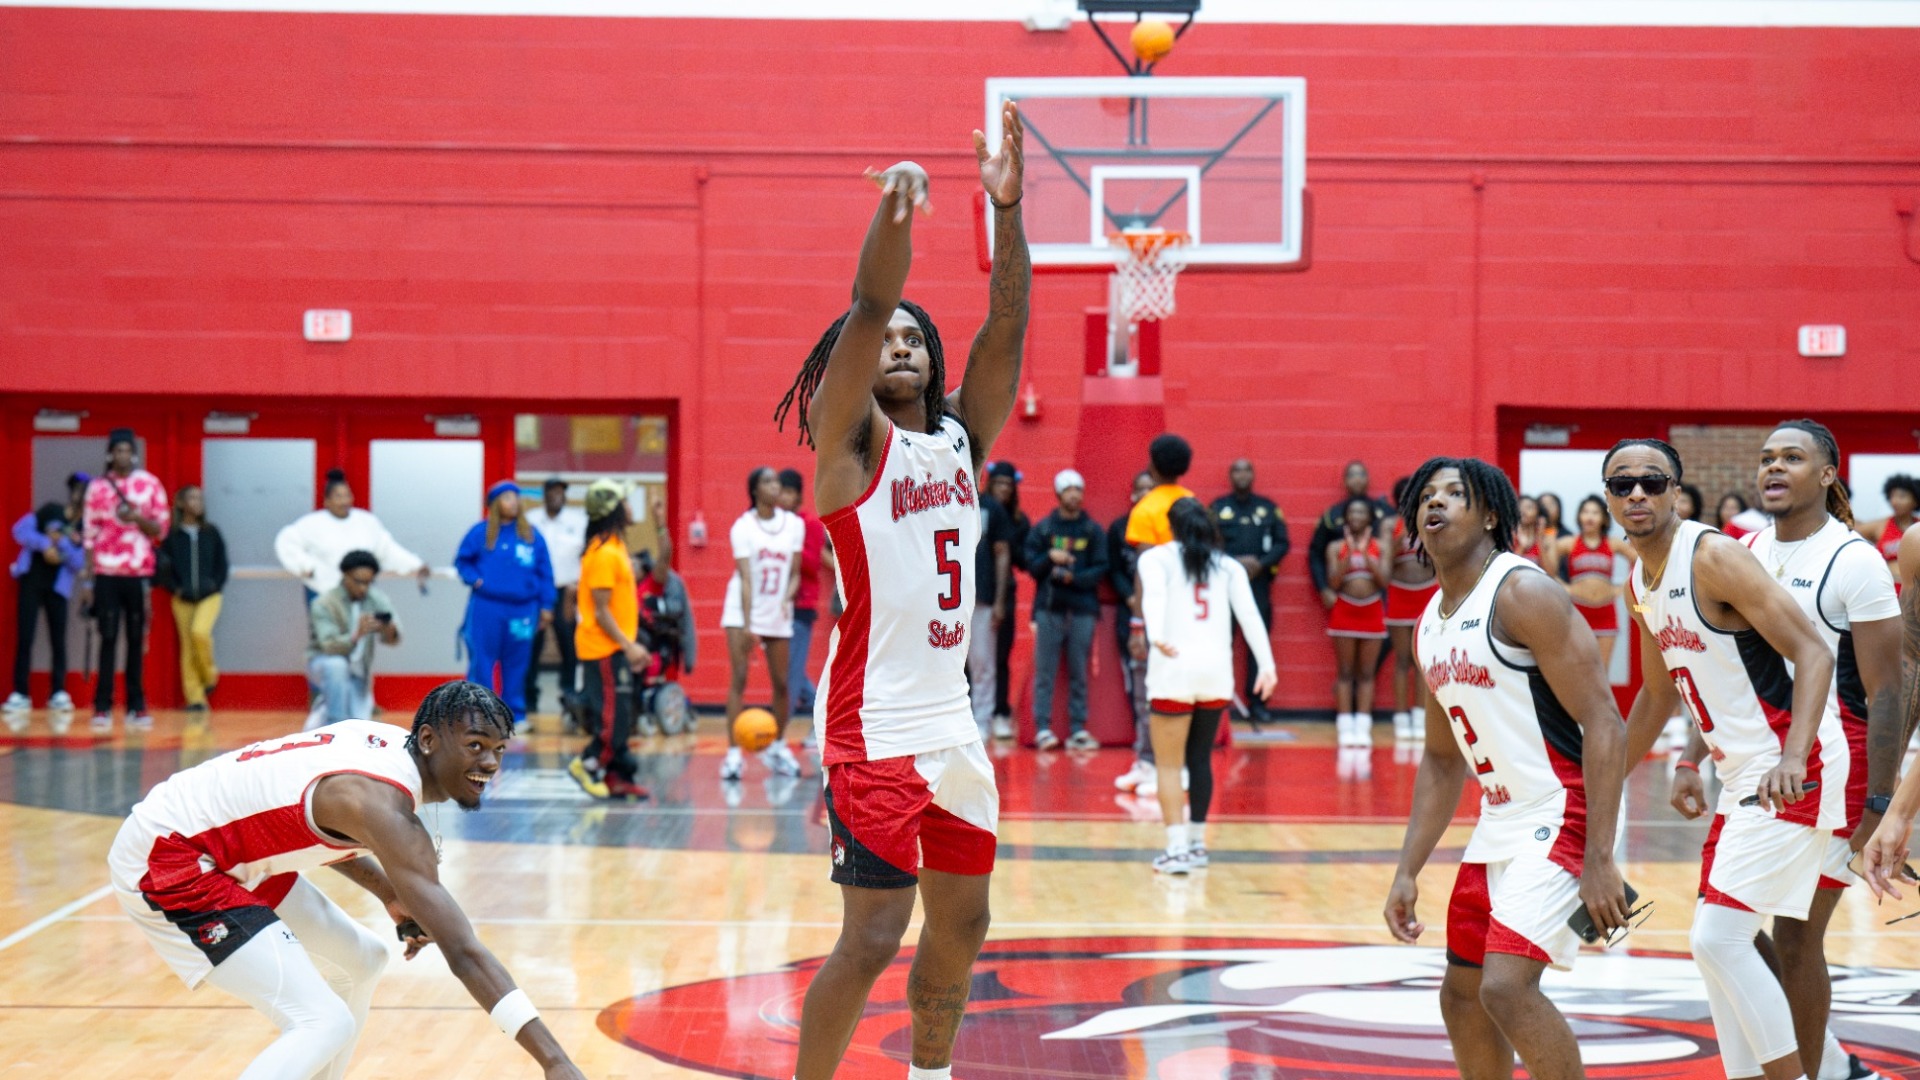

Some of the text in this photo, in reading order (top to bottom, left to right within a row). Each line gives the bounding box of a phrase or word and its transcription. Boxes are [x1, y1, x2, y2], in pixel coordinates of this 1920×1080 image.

[759, 566, 781, 596] 13
[934, 528, 961, 611] 5
[1791, 577, 1815, 589] CIAA
[1193, 582, 1210, 621] 5
[928, 618, 965, 650] State
[1461, 617, 1481, 631] CIAA
[1449, 705, 1495, 775] 2
